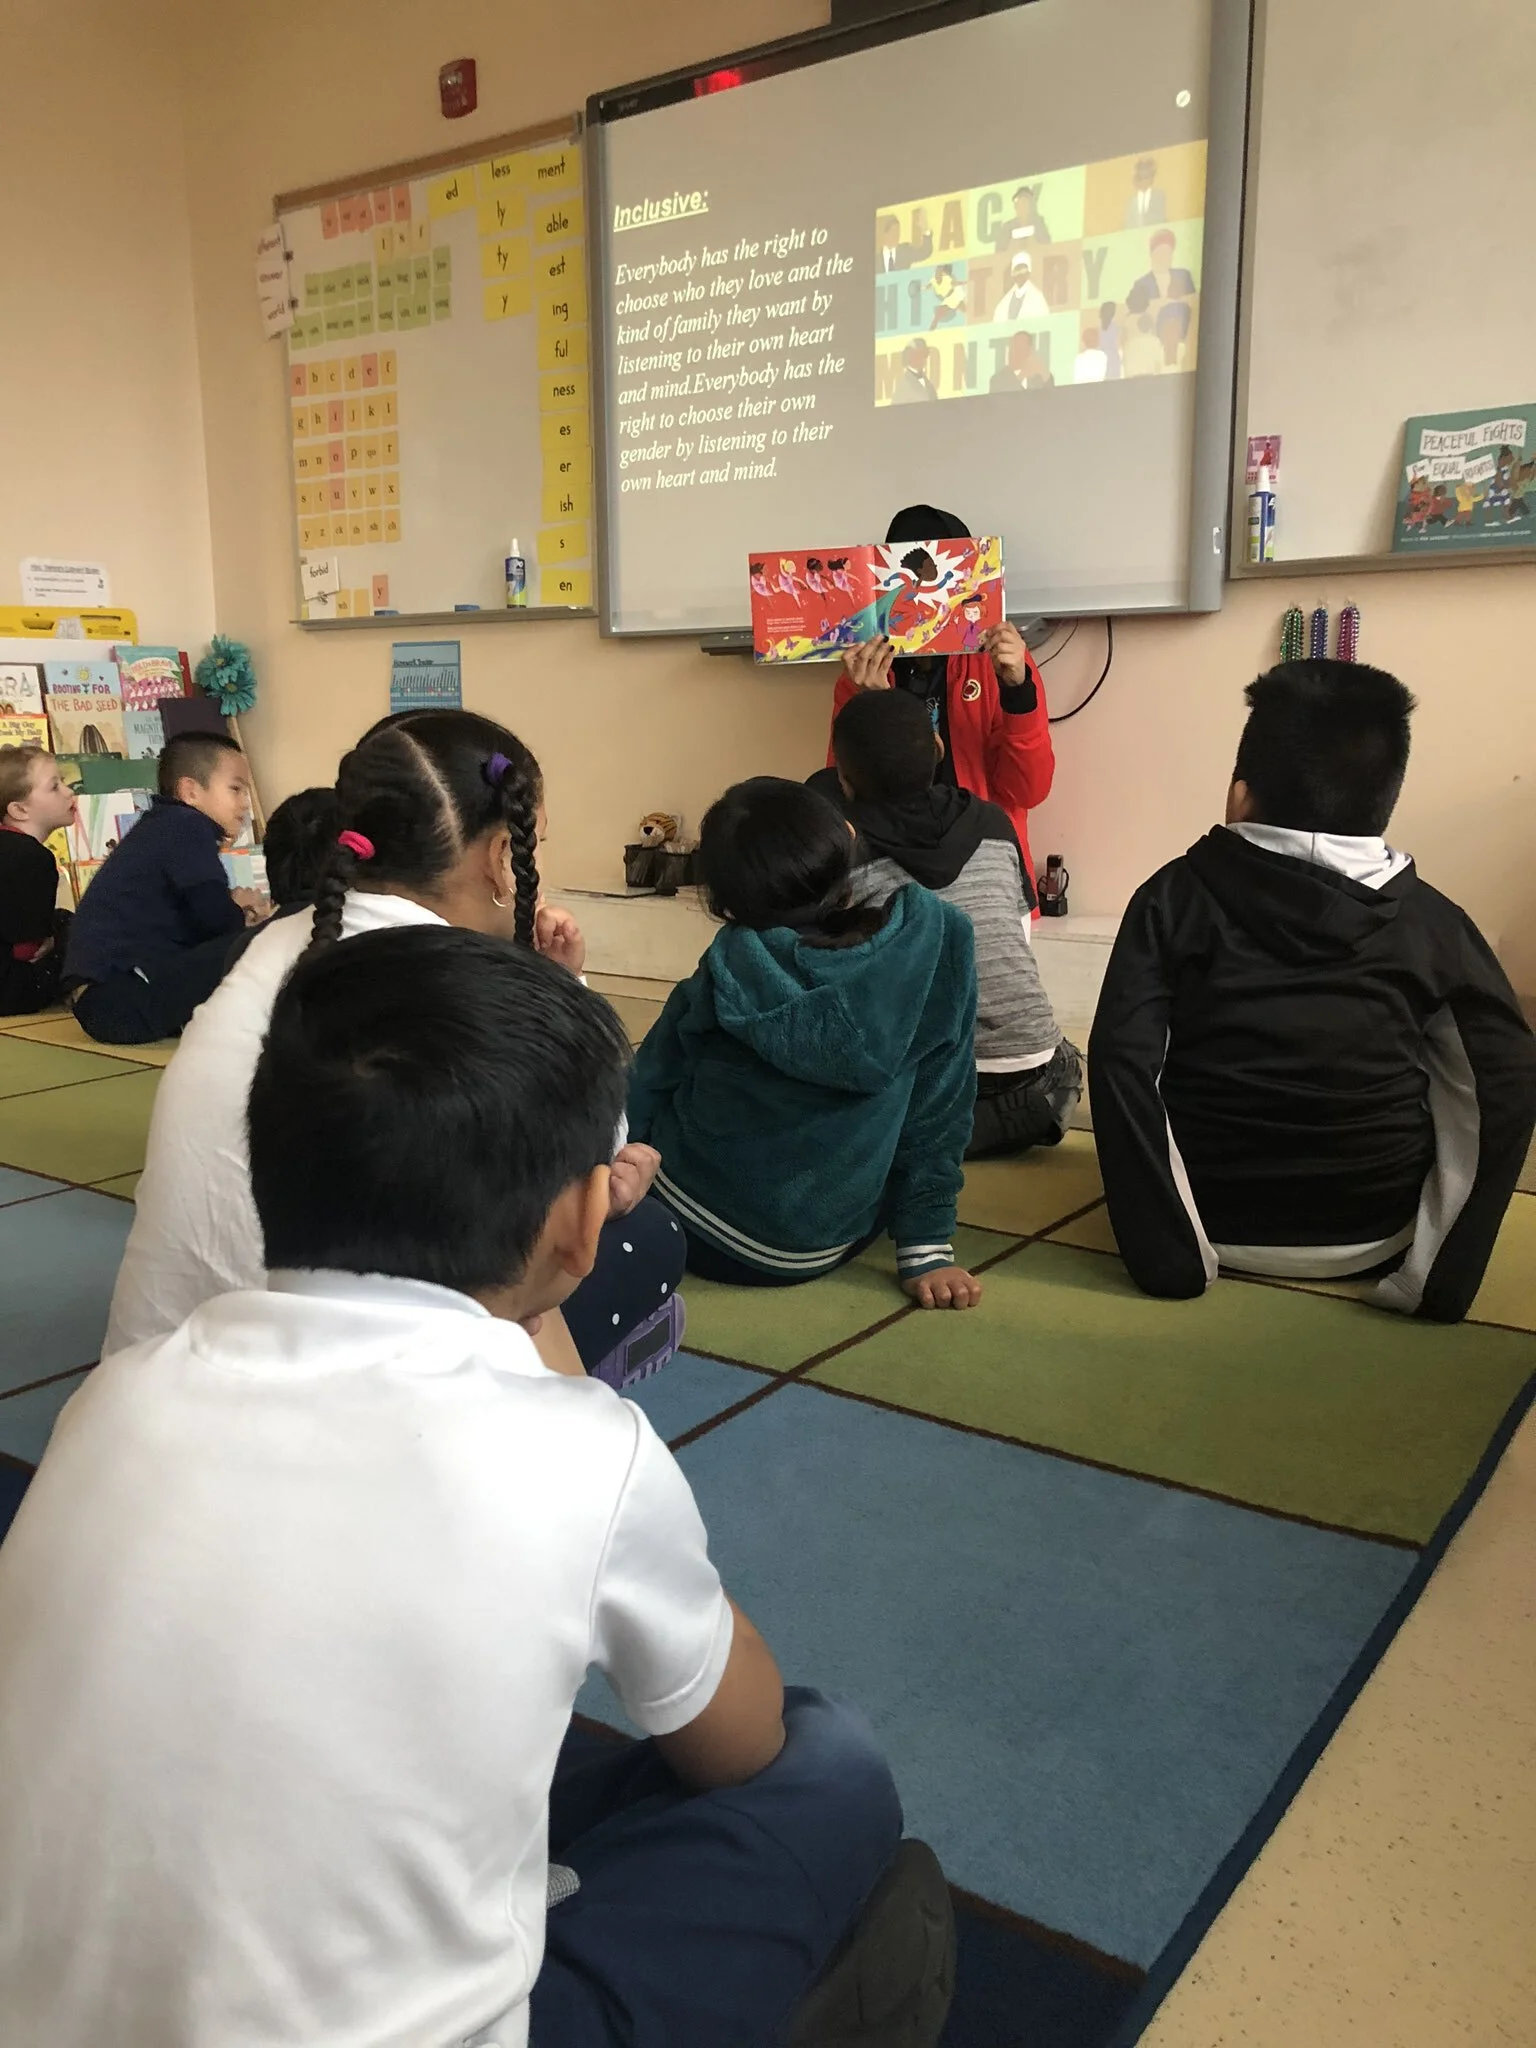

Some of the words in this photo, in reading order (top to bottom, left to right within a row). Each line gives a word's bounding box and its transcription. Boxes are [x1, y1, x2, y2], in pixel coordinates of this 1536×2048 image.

[491, 161, 511, 180] less
[537, 156, 566, 179] ment
[446, 179, 459, 201] ed
[497, 200, 506, 227] ly
[613, 190, 709, 231] Inclusive:
[546, 212, 569, 234] able
[497, 245, 508, 271] ty
[549, 255, 566, 277] est
[614, 250, 697, 286] Everybody
[701, 246, 729, 268] has
[734, 238, 760, 261] the
[763, 228, 806, 258] right
[810, 227, 828, 246] to
[615, 293, 669, 315] choose
[673, 282, 705, 304] who
[710, 275, 744, 299] they
[748, 269, 784, 290] love
[787, 256, 823, 283] and
[826, 252, 854, 277] the
[501, 294, 508, 314] y
[552, 302, 569, 322] ing
[616, 320, 650, 345] kind
[653, 316, 672, 344] of
[671, 308, 722, 341] family
[726, 304, 761, 328] they
[765, 293, 807, 319] want
[811, 290, 833, 316] by
[554, 339, 568, 358] ful
[617, 350, 683, 376] listening
[686, 348, 702, 364] to
[706, 339, 745, 361] their
[749, 334, 784, 353] own
[788, 323, 835, 347] heart
[311, 372, 319, 383] b
[329, 373, 336, 381] c
[348, 367, 355, 379] d
[366, 367, 373, 376] e
[618, 381, 648, 405] and
[650, 362, 779, 400] mind.Everybody
[783, 359, 813, 381] has
[818, 353, 846, 375] the
[553, 383, 576, 398] ness
[315, 413, 321, 424] h
[368, 405, 375, 416] k
[619, 411, 655, 438] right
[659, 411, 674, 429] to
[678, 405, 733, 427] choose
[737, 396, 777, 419] their
[780, 393, 816, 413] own
[559, 424, 571, 436] es
[619, 440, 672, 469] gender
[675, 437, 695, 462] by
[698, 430, 767, 455] listening
[771, 427, 787, 445] to
[792, 420, 834, 444] their
[1423, 432, 1478, 452] PEACEFUL
[299, 459, 308, 467] m
[316, 457, 322, 465] n
[332, 453, 339, 461] o
[350, 448, 358, 460] p
[387, 444, 392, 453] r
[559, 462, 572, 472] er
[621, 475, 651, 493] own
[655, 469, 696, 489] heart
[699, 462, 731, 484] and
[733, 456, 778, 481] mind.
[1432, 461, 1462, 478] EQUAL
[301, 495, 307, 503] s
[334, 491, 340, 500] u
[368, 487, 376, 495] w
[388, 485, 394, 493] x
[559, 494, 574, 512] ish
[304, 530, 310, 542] y
[320, 528, 325, 537] z
[559, 538, 565, 549] s
[309, 562, 329, 578] forbid
[559, 581, 572, 591] en
[92, 684, 111, 694] FOR
[52, 700, 70, 711] THE
[73, 700, 93, 713] BAD
[96, 700, 118, 712] SEED
